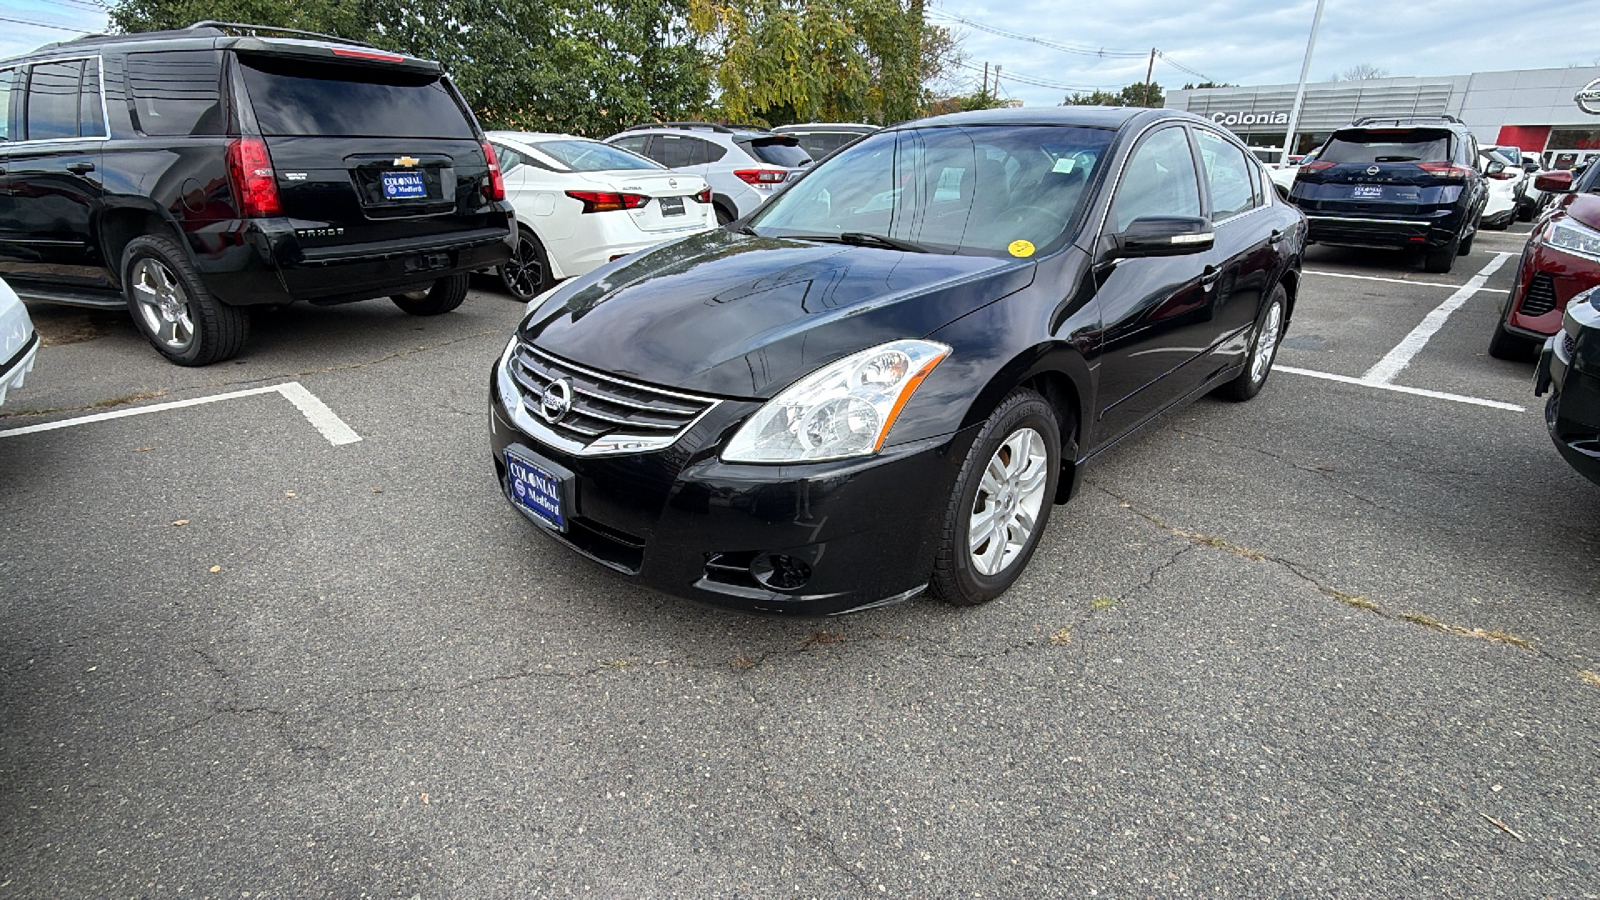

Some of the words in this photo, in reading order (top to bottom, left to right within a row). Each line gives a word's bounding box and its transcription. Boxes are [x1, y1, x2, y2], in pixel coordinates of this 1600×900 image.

[1211, 111, 1292, 125] Colonia
[384, 176, 422, 186] COLONIAL
[398, 185, 422, 193] Medford
[298, 228, 344, 238] TAHOE
[510, 462, 560, 501] COLONIAL
[528, 487, 560, 516] Medford
